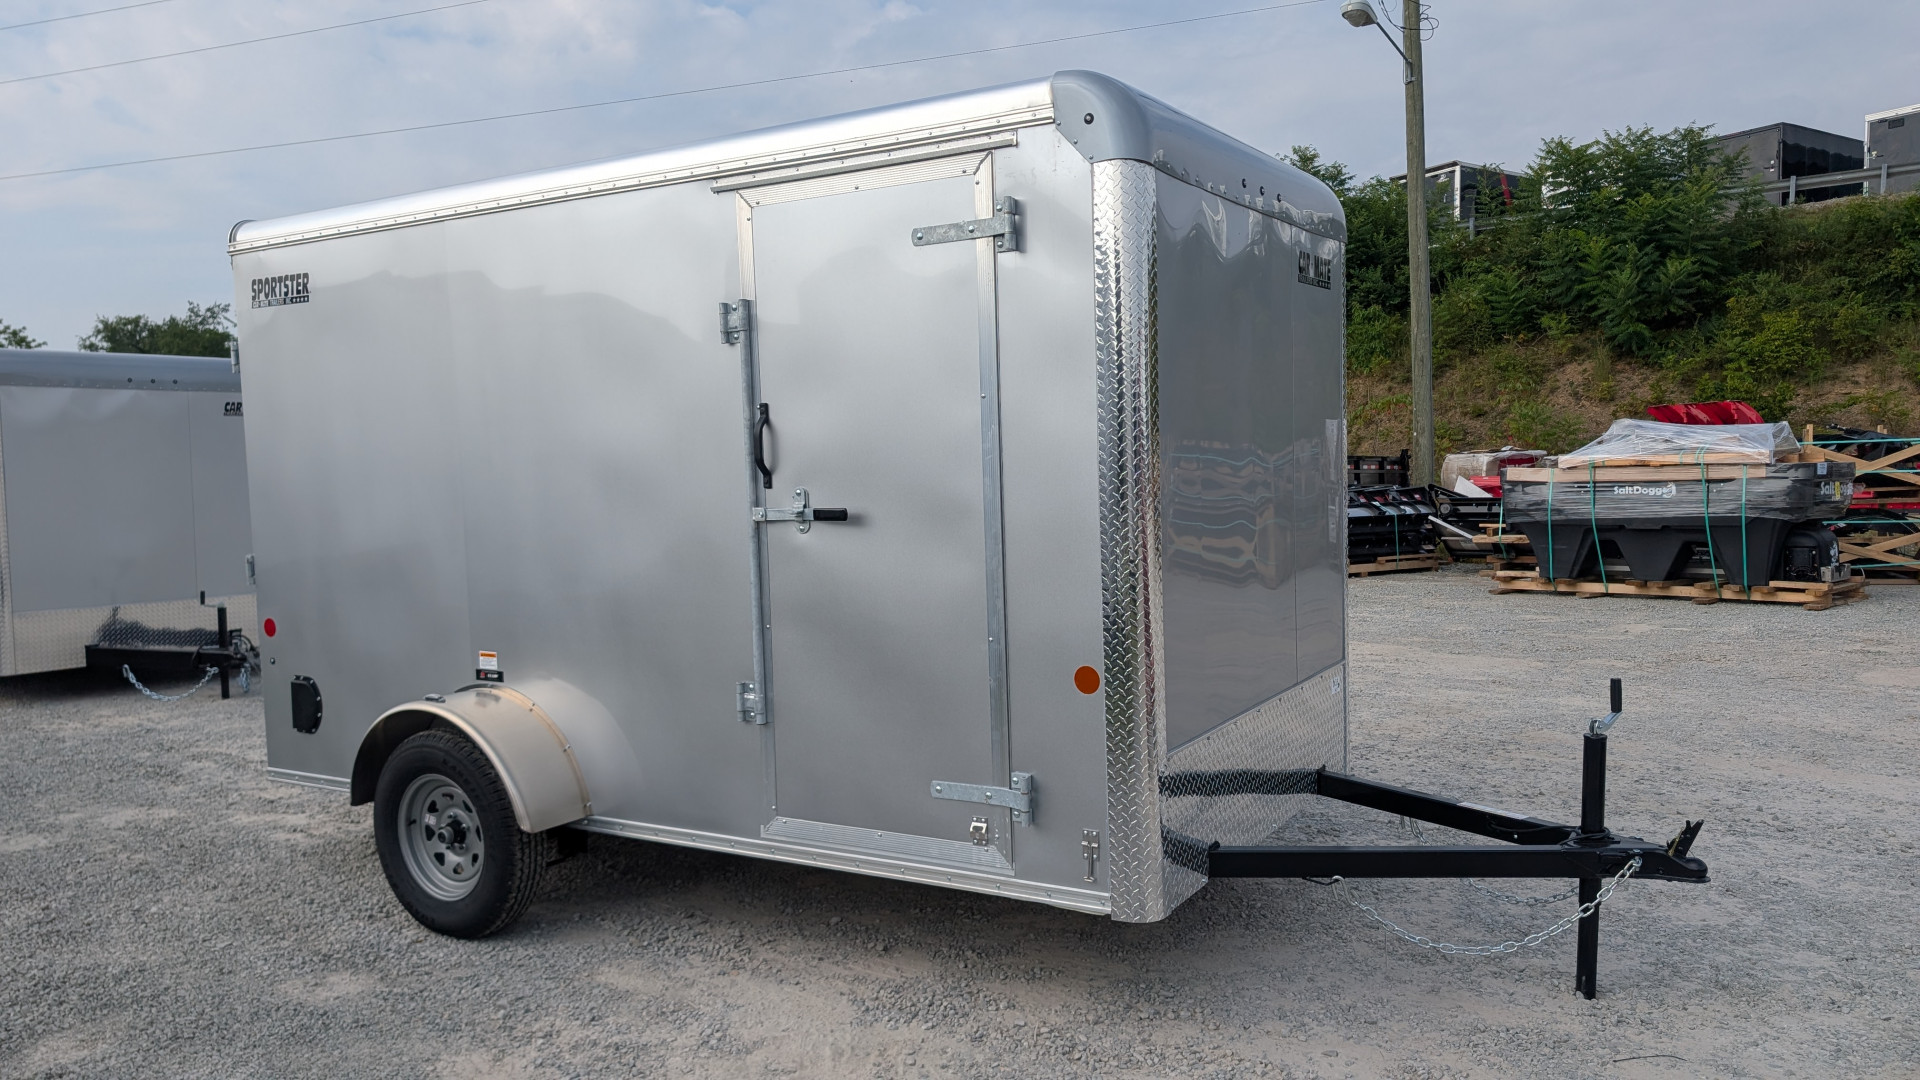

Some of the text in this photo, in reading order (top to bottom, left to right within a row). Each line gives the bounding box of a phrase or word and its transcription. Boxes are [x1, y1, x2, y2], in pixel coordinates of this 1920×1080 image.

[251, 272, 310, 301] SPORTSTER
[224, 401, 243, 413] CAR
[1613, 485, 1663, 496] SaltDogg
